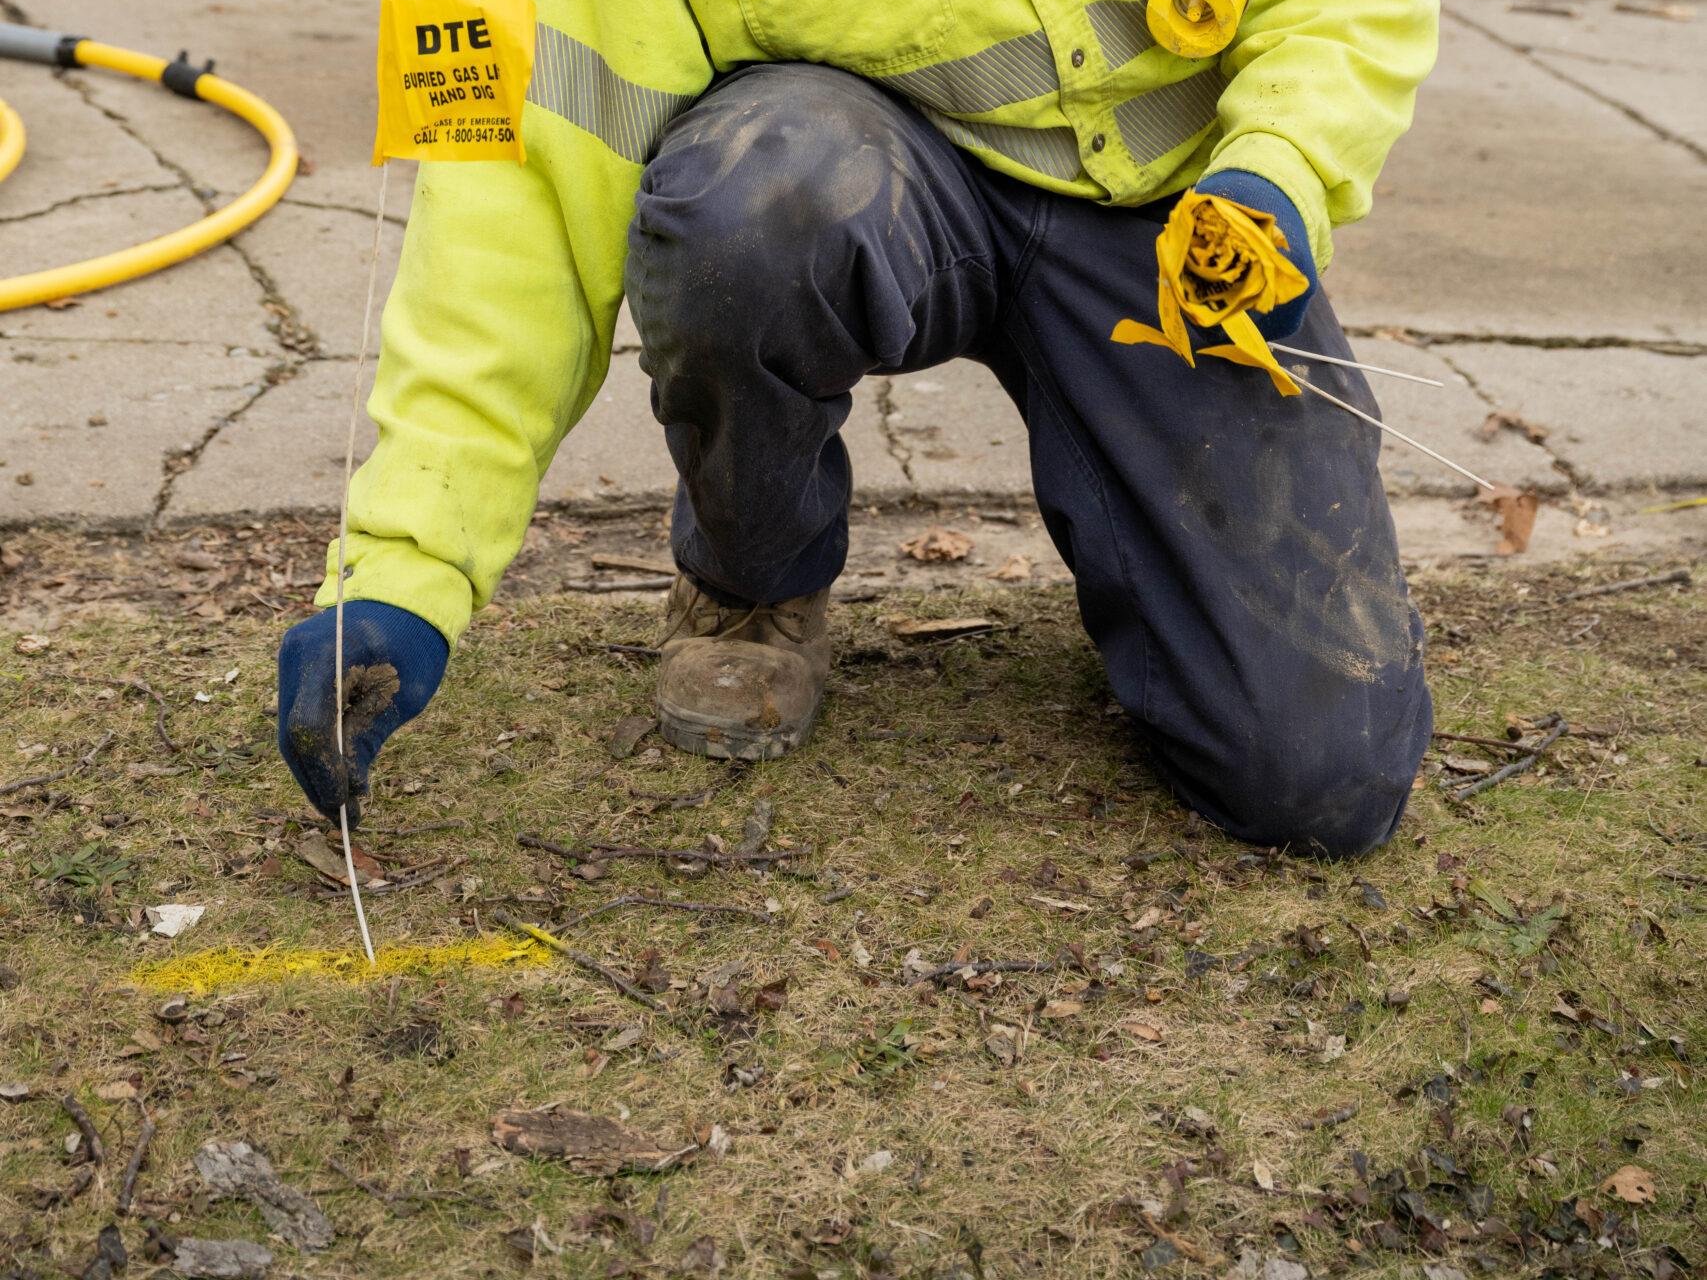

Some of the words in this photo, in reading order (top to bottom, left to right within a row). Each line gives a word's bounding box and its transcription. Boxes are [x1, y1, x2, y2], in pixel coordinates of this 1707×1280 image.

[415, 17, 492, 56] DTE
[403, 70, 446, 90] BURIED
[452, 65, 480, 83] GAS
[485, 63, 500, 81] LI
[428, 86, 466, 107] HAND
[471, 84, 496, 100] DIG
[457, 117, 466, 126] OF
[413, 128, 438, 145] CALL
